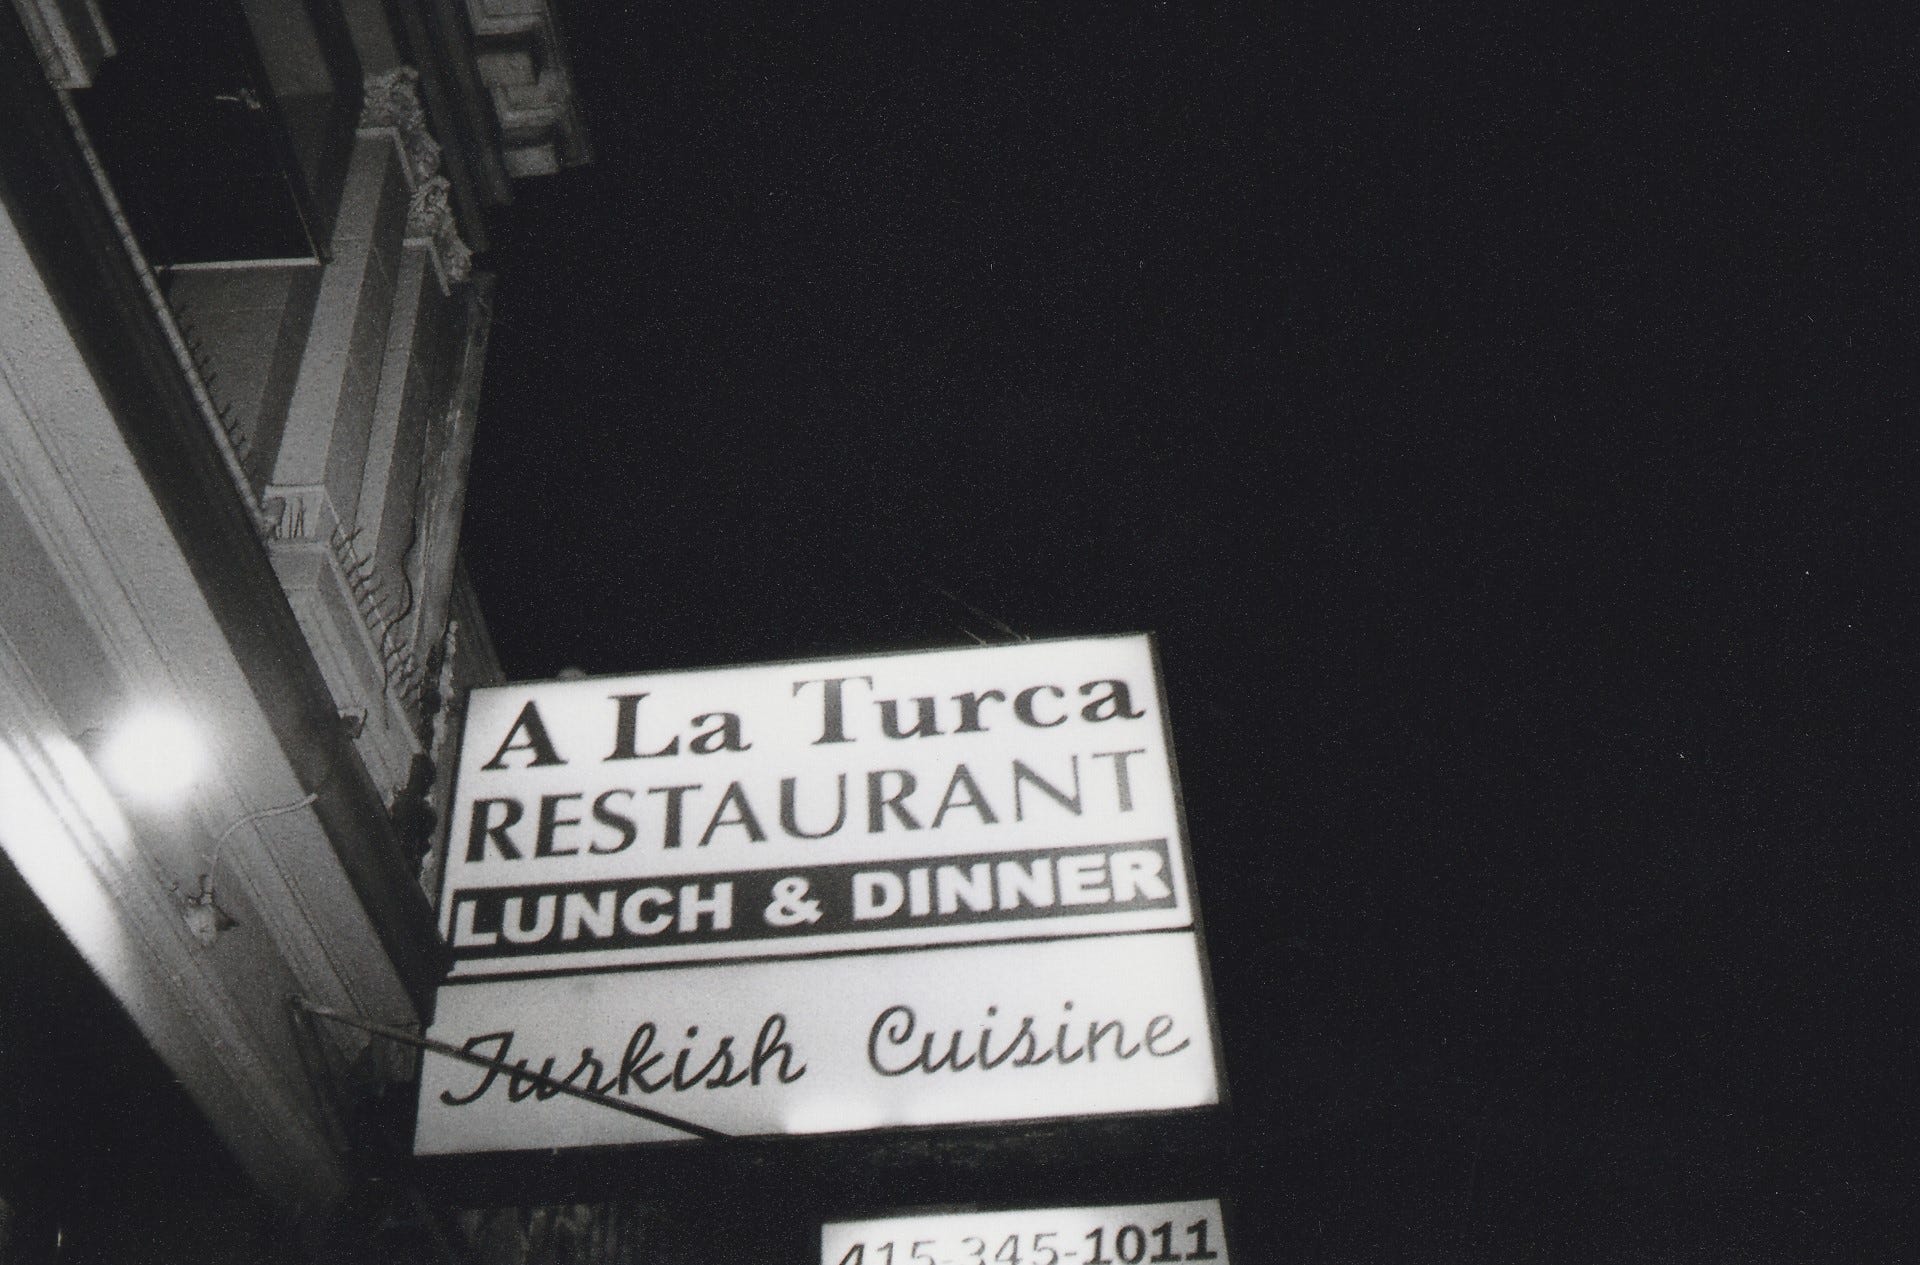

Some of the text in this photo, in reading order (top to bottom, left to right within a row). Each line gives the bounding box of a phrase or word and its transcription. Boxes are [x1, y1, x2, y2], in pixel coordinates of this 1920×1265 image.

[480, 675, 1147, 771] A La Turca
[464, 748, 1146, 864] RESTAURANT
[453, 849, 1171, 948] LUNCH & DINNER
[439, 1000, 1191, 1106] Turkish Cuisine
